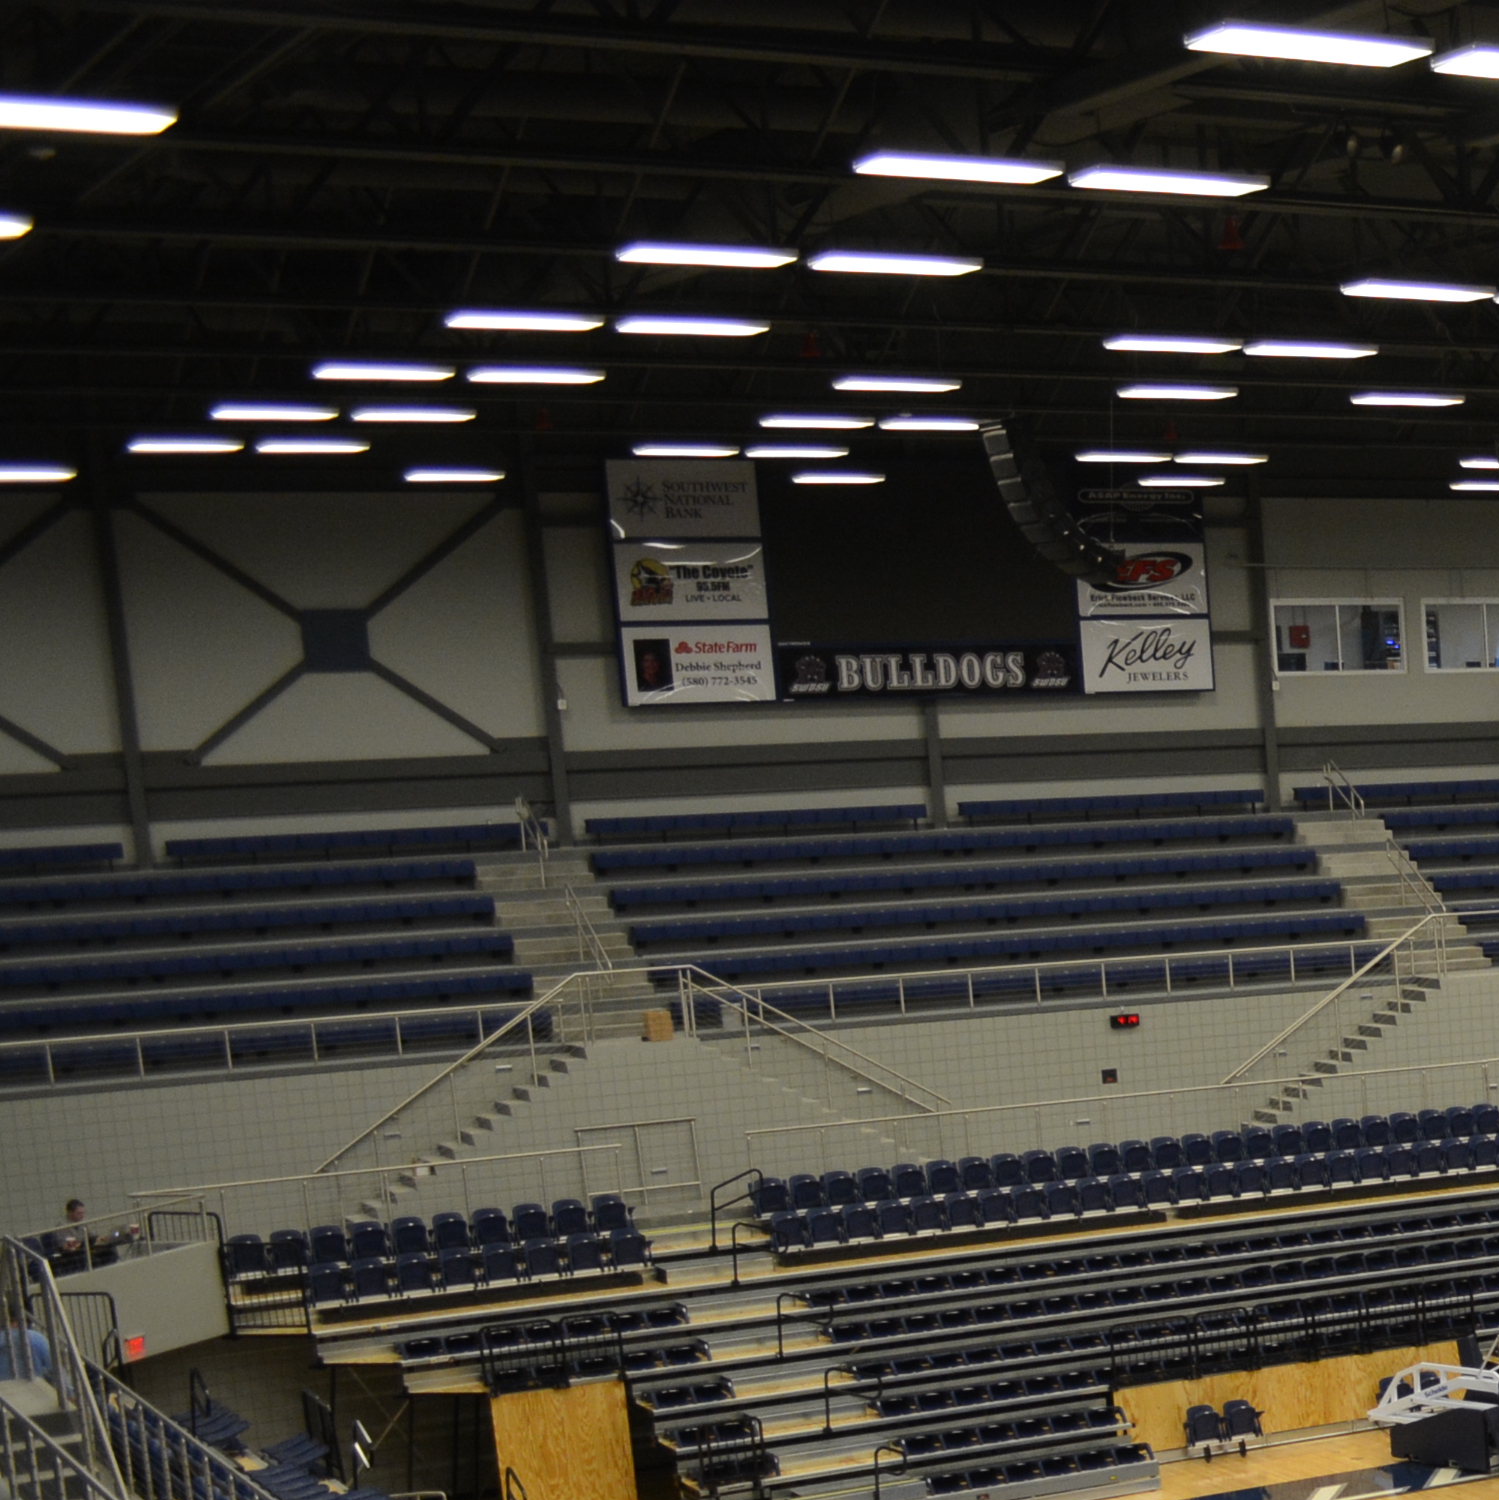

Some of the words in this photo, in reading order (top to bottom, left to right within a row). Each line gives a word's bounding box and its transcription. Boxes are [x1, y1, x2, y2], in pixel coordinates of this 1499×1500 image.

[662, 481, 748, 494] SOUTHWEST
[664, 494, 735, 506] NATIONAL
[665, 507, 703, 519] BANK
[685, 595, 705, 603] LIVE
[713, 594, 742, 603] LOCAL
[1099, 628, 1196, 678] Kelley
[675, 662, 712, 673] Debbie
[714, 661, 762, 674] Shepherd
[835, 652, 1026, 691] BULLDOGS
[682, 677, 709, 687] (580)
[1127, 672, 1189, 684] JEWELERS
